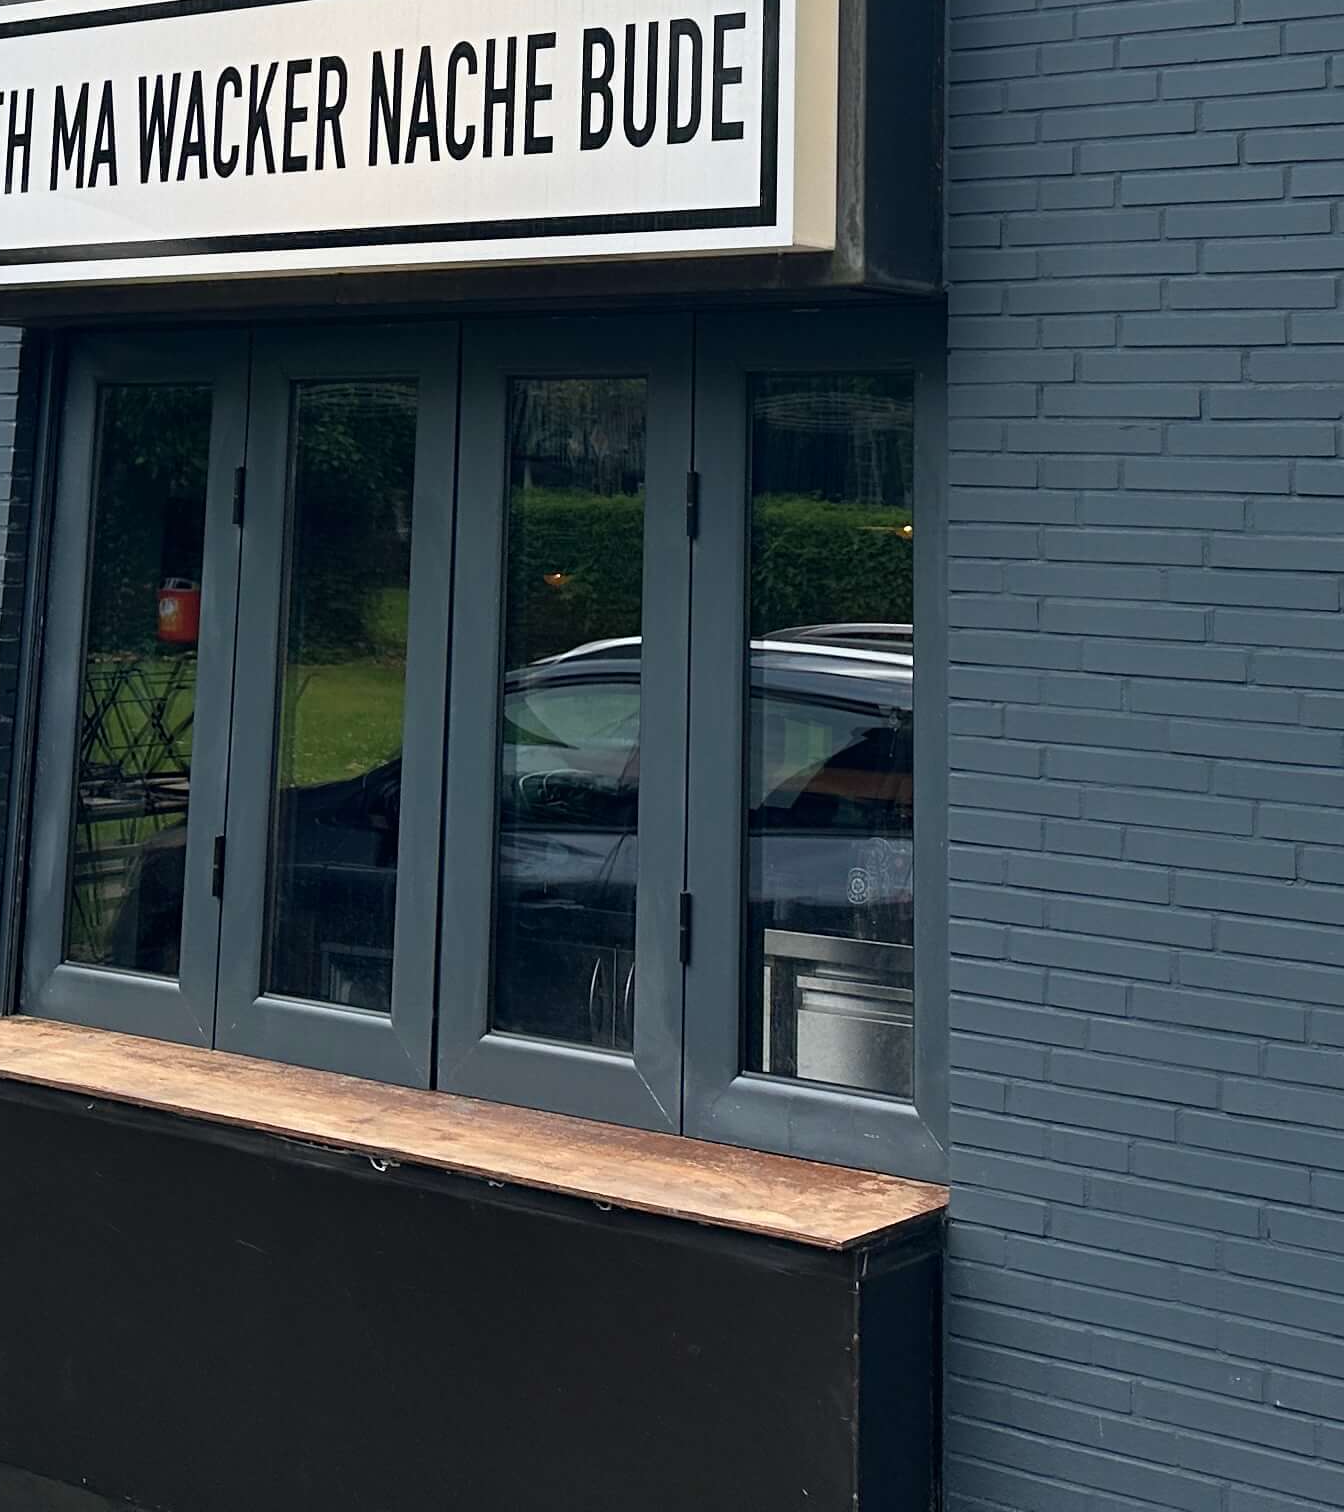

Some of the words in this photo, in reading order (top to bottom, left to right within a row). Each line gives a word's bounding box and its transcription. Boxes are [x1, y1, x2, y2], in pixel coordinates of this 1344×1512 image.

[49, 79, 119, 192] MA
[138, 54, 349, 185] WACKER
[368, 31, 557, 167] NACHE
[580, 11, 748, 151] BUDE
